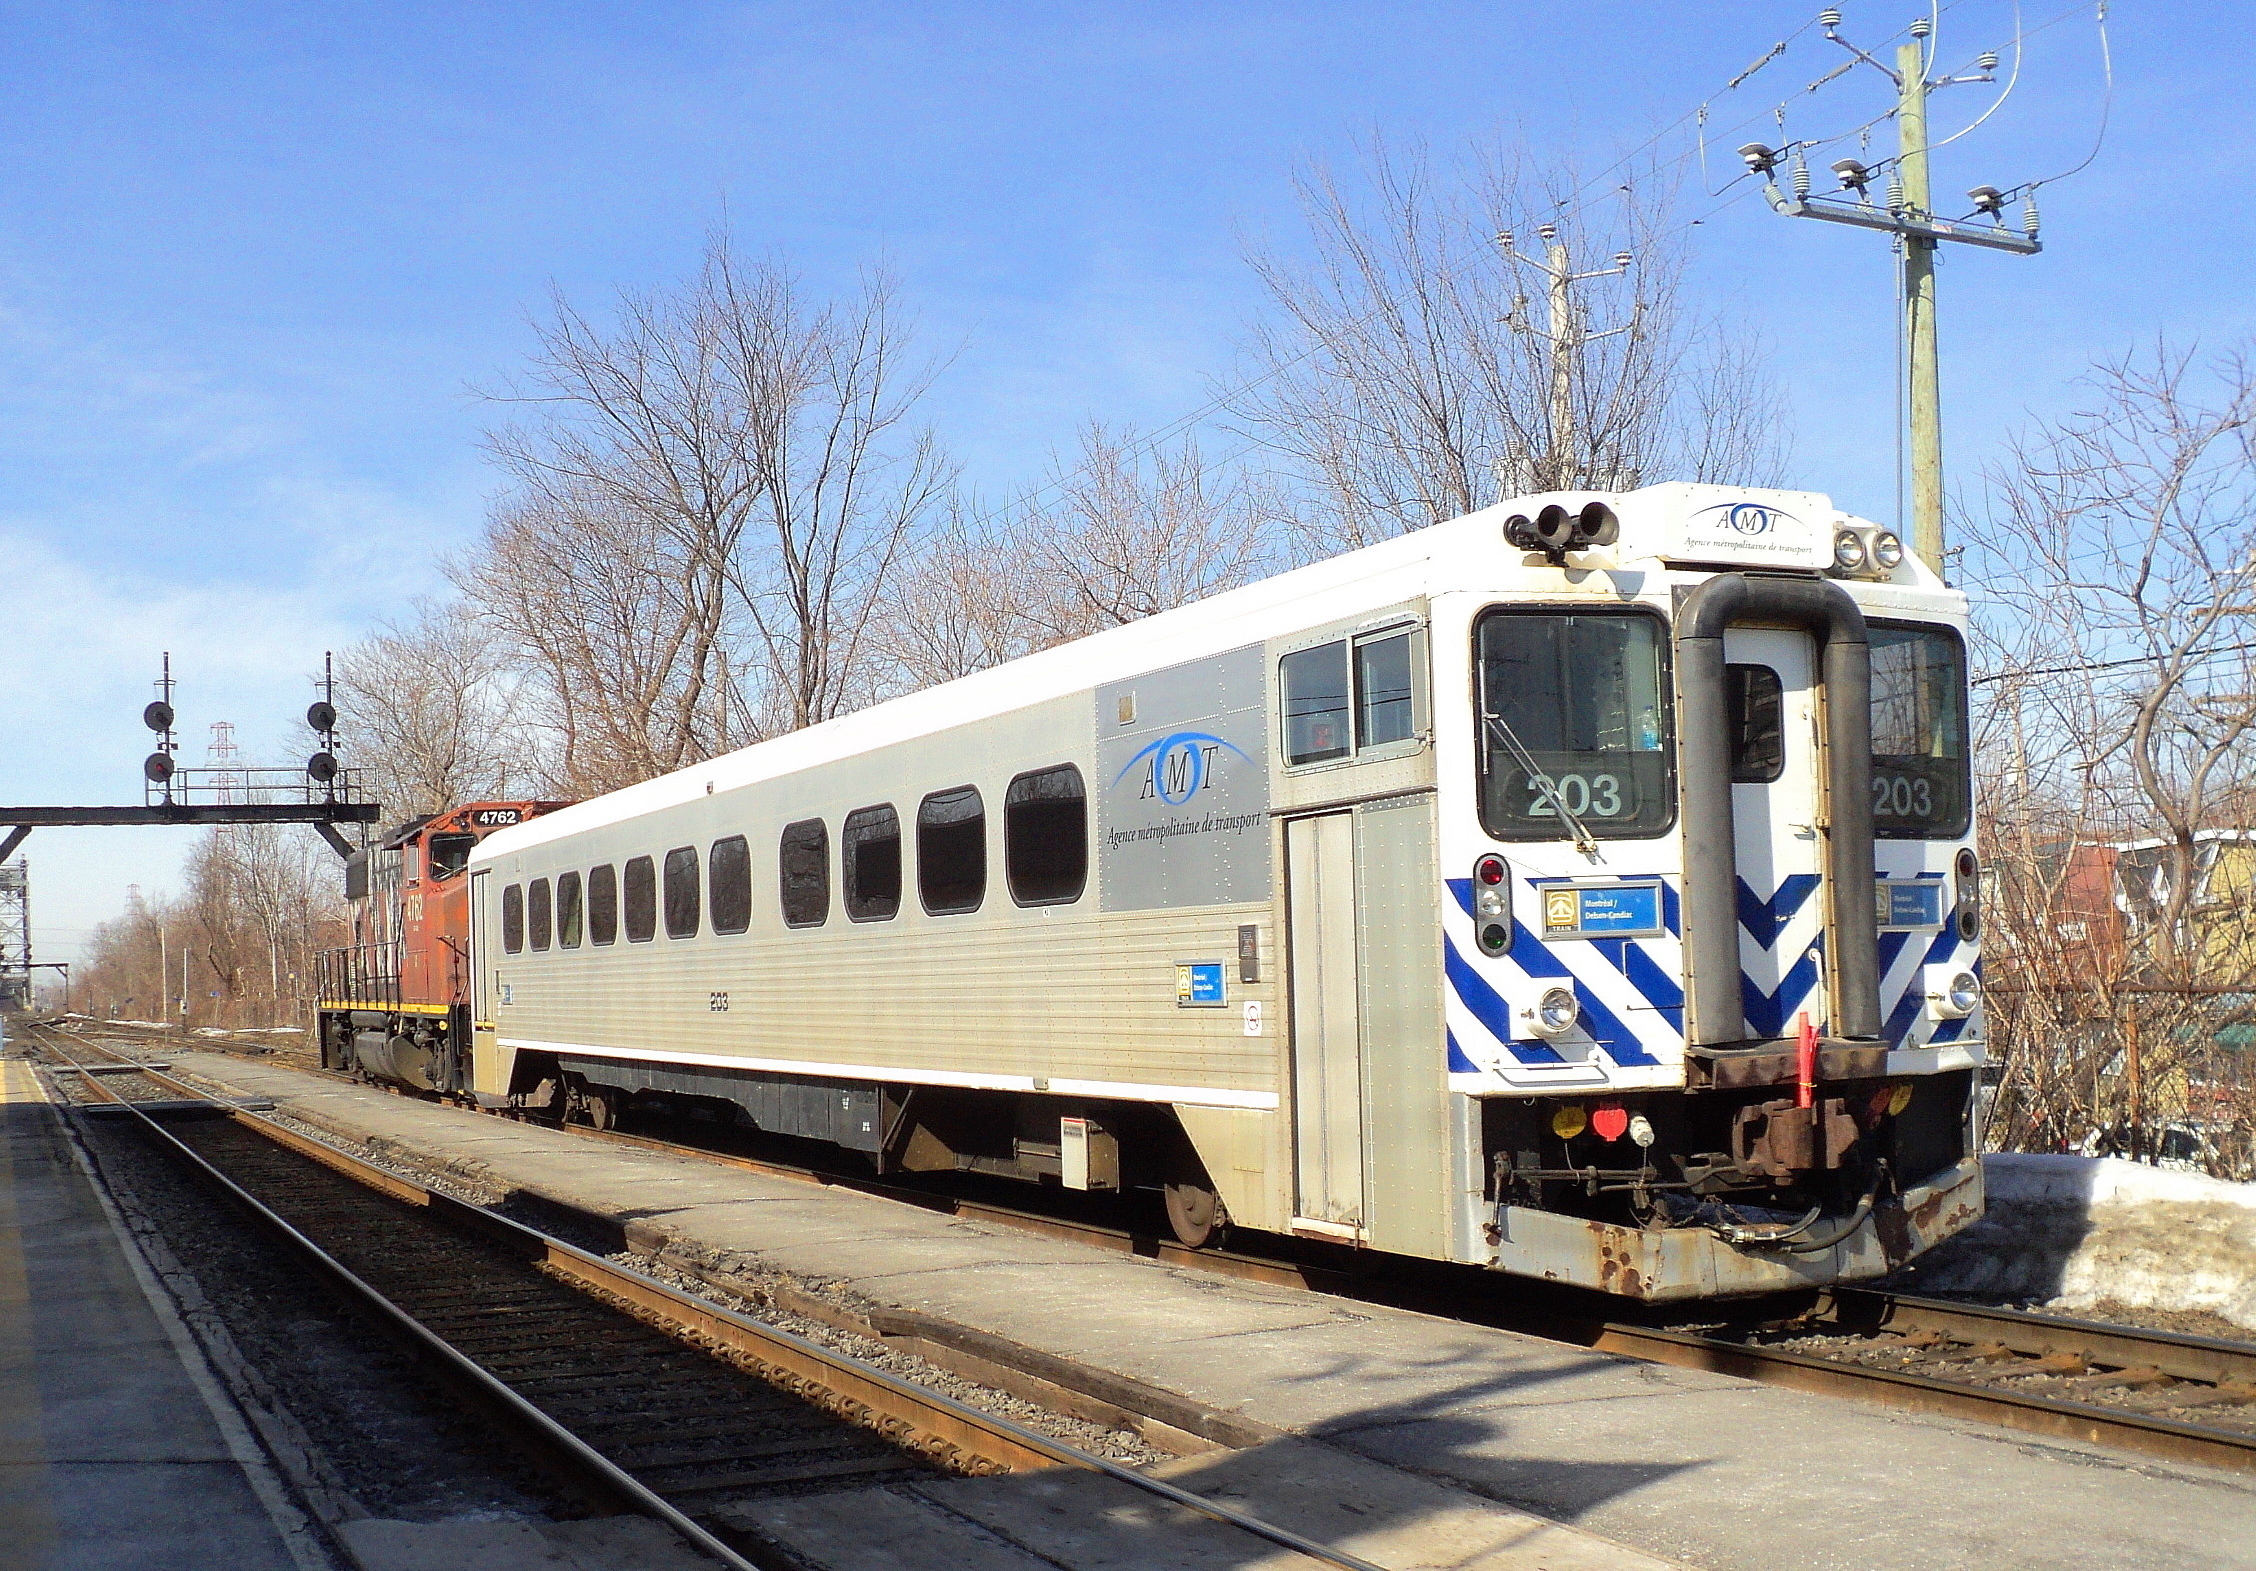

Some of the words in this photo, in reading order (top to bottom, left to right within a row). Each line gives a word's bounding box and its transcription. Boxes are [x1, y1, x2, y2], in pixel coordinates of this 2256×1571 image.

[1684, 537, 1711, 548] Agence
[1713, 539, 1767, 551] métropolitaine
[1768, 542, 1777, 551] de
[1779, 545, 1812, 555] transport
[1528, 774, 1621, 817] 203
[1872, 776, 1932, 817] 203
[479, 811, 517, 824] 4762
[1107, 826, 1136, 850] Agence
[1138, 816, 1200, 844] métropolitaine
[1202, 812, 1216, 833] de
[1216, 811, 1262, 835] transport
[406, 893, 423, 922] 4762
[710, 992, 729, 1011] 203
